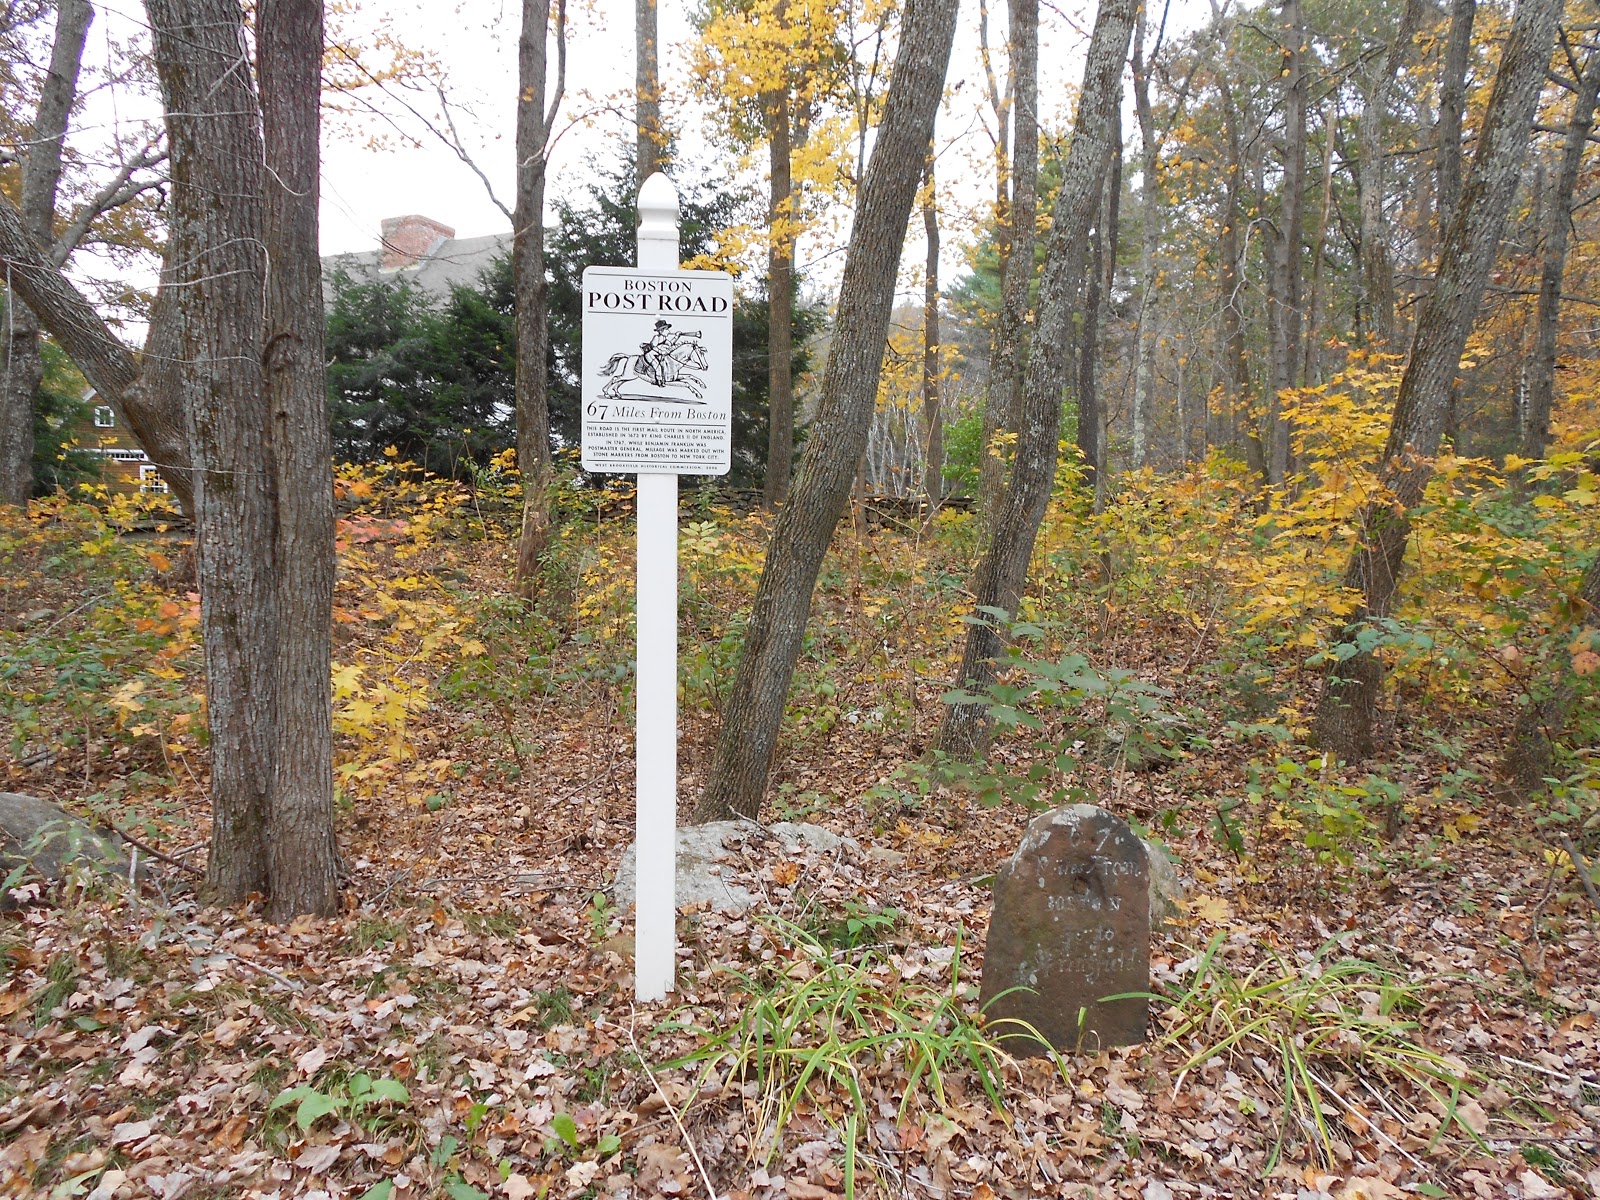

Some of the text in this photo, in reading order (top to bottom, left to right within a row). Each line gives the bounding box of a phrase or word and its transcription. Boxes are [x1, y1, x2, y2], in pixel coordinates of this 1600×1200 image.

[624, 279, 692, 293] BOSTON
[588, 291, 728, 313] POST ROAD
[587, 400, 726, 420] 67 Miles From Boston
